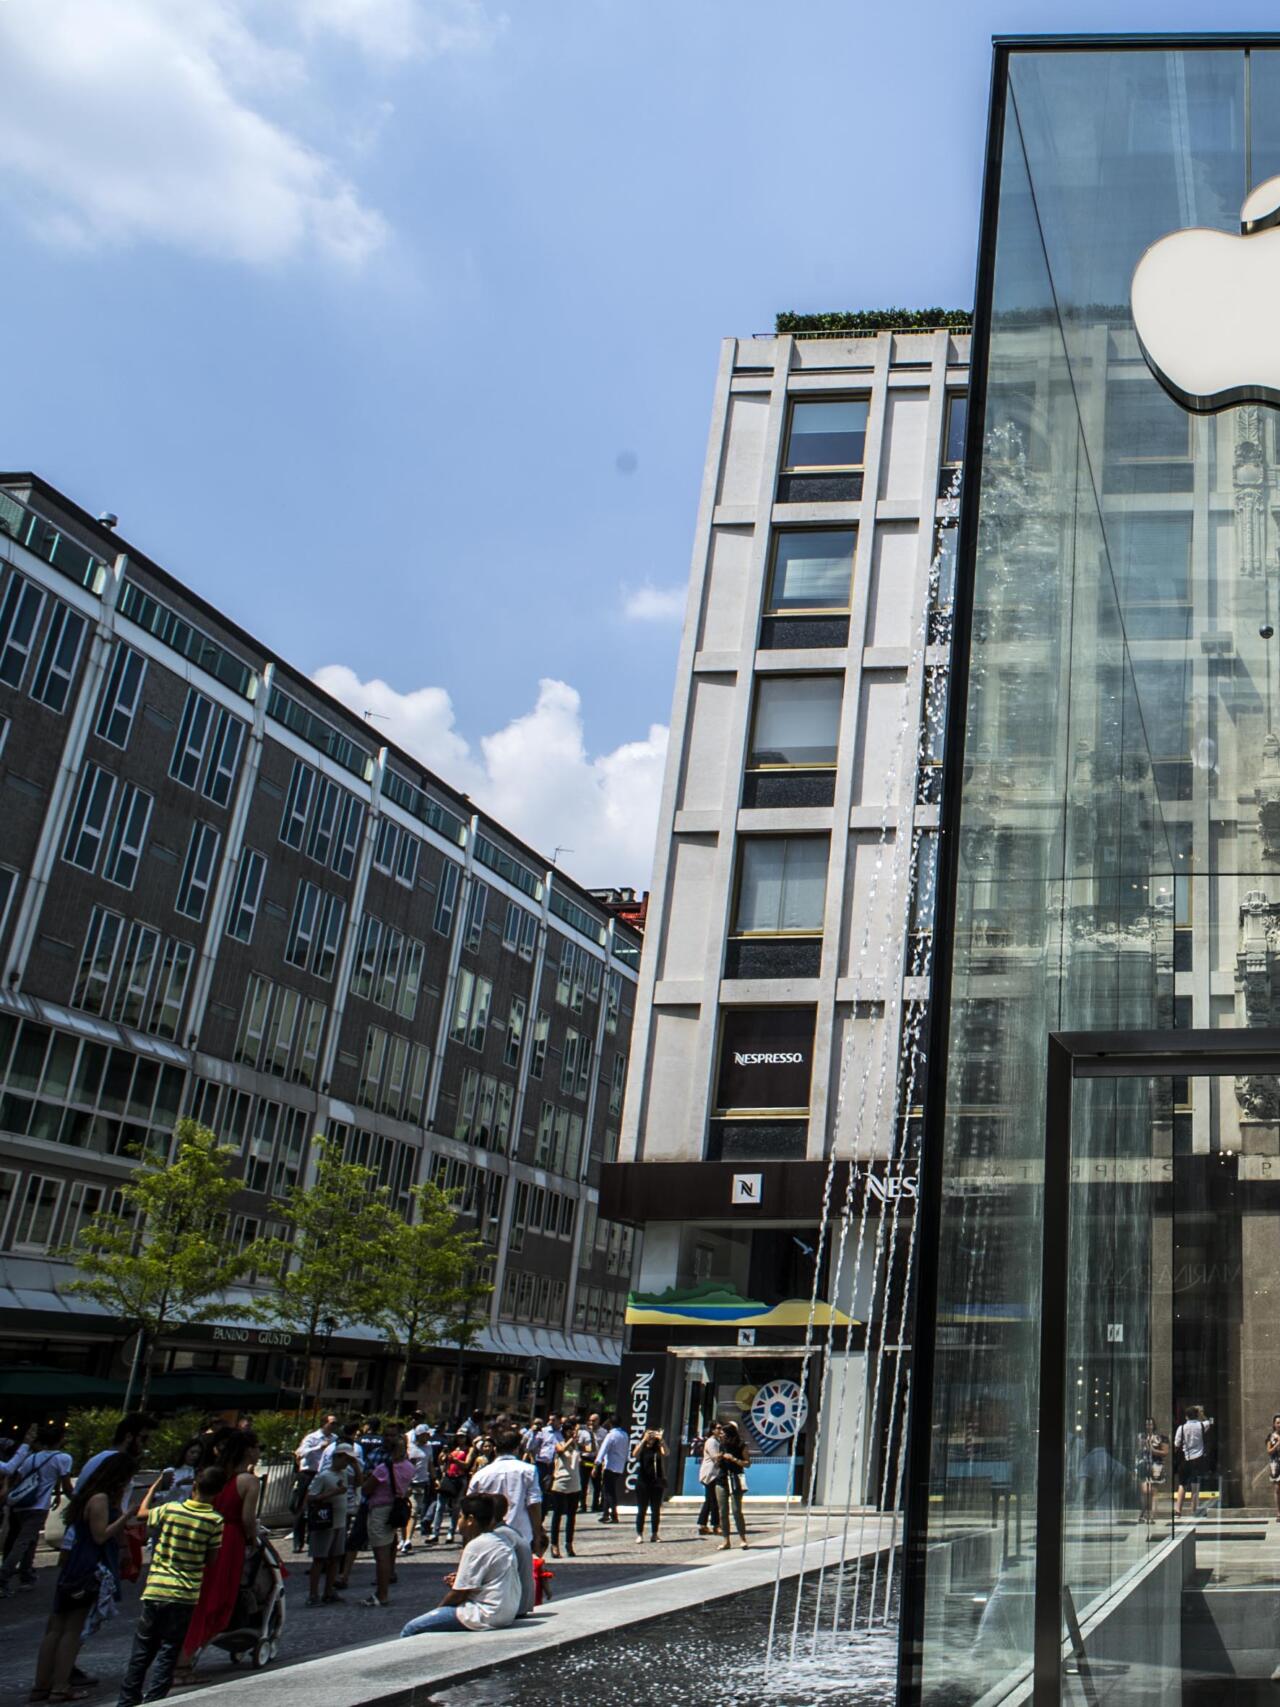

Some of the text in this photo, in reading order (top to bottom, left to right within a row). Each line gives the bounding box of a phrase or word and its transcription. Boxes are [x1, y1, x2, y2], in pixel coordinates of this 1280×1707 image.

[733, 1052, 803, 1066] NESPRESSO
[738, 1179, 757, 1198] N
[213, 1327, 292, 1346] PANINO GIUSTO
